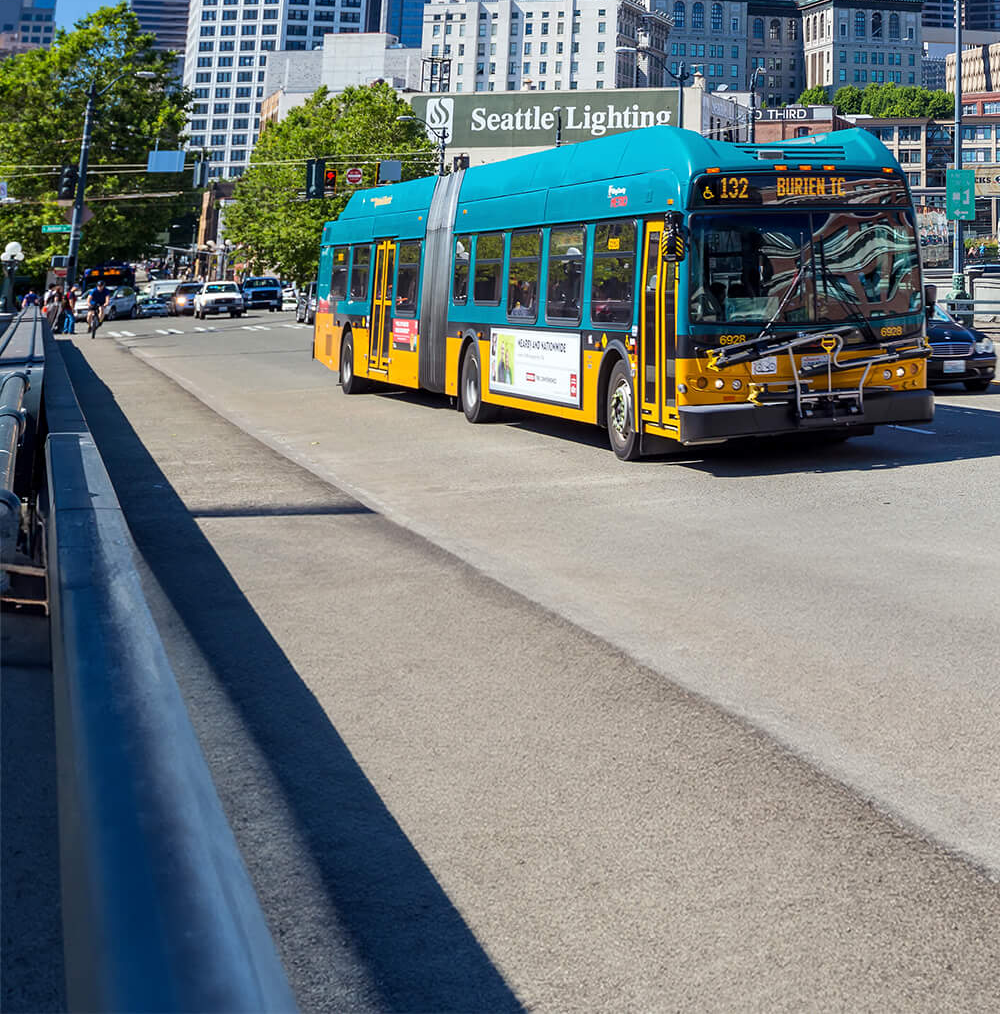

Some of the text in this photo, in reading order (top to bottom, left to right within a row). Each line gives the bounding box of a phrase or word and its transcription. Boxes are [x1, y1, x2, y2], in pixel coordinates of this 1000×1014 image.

[471, 104, 672, 136] Seattle Lighting
[767, 109, 807, 120] THIRD
[719, 177, 846, 199] 132 BURIEN TC
[880, 326, 903, 337] 6928
[719, 334, 746, 346] 6928
